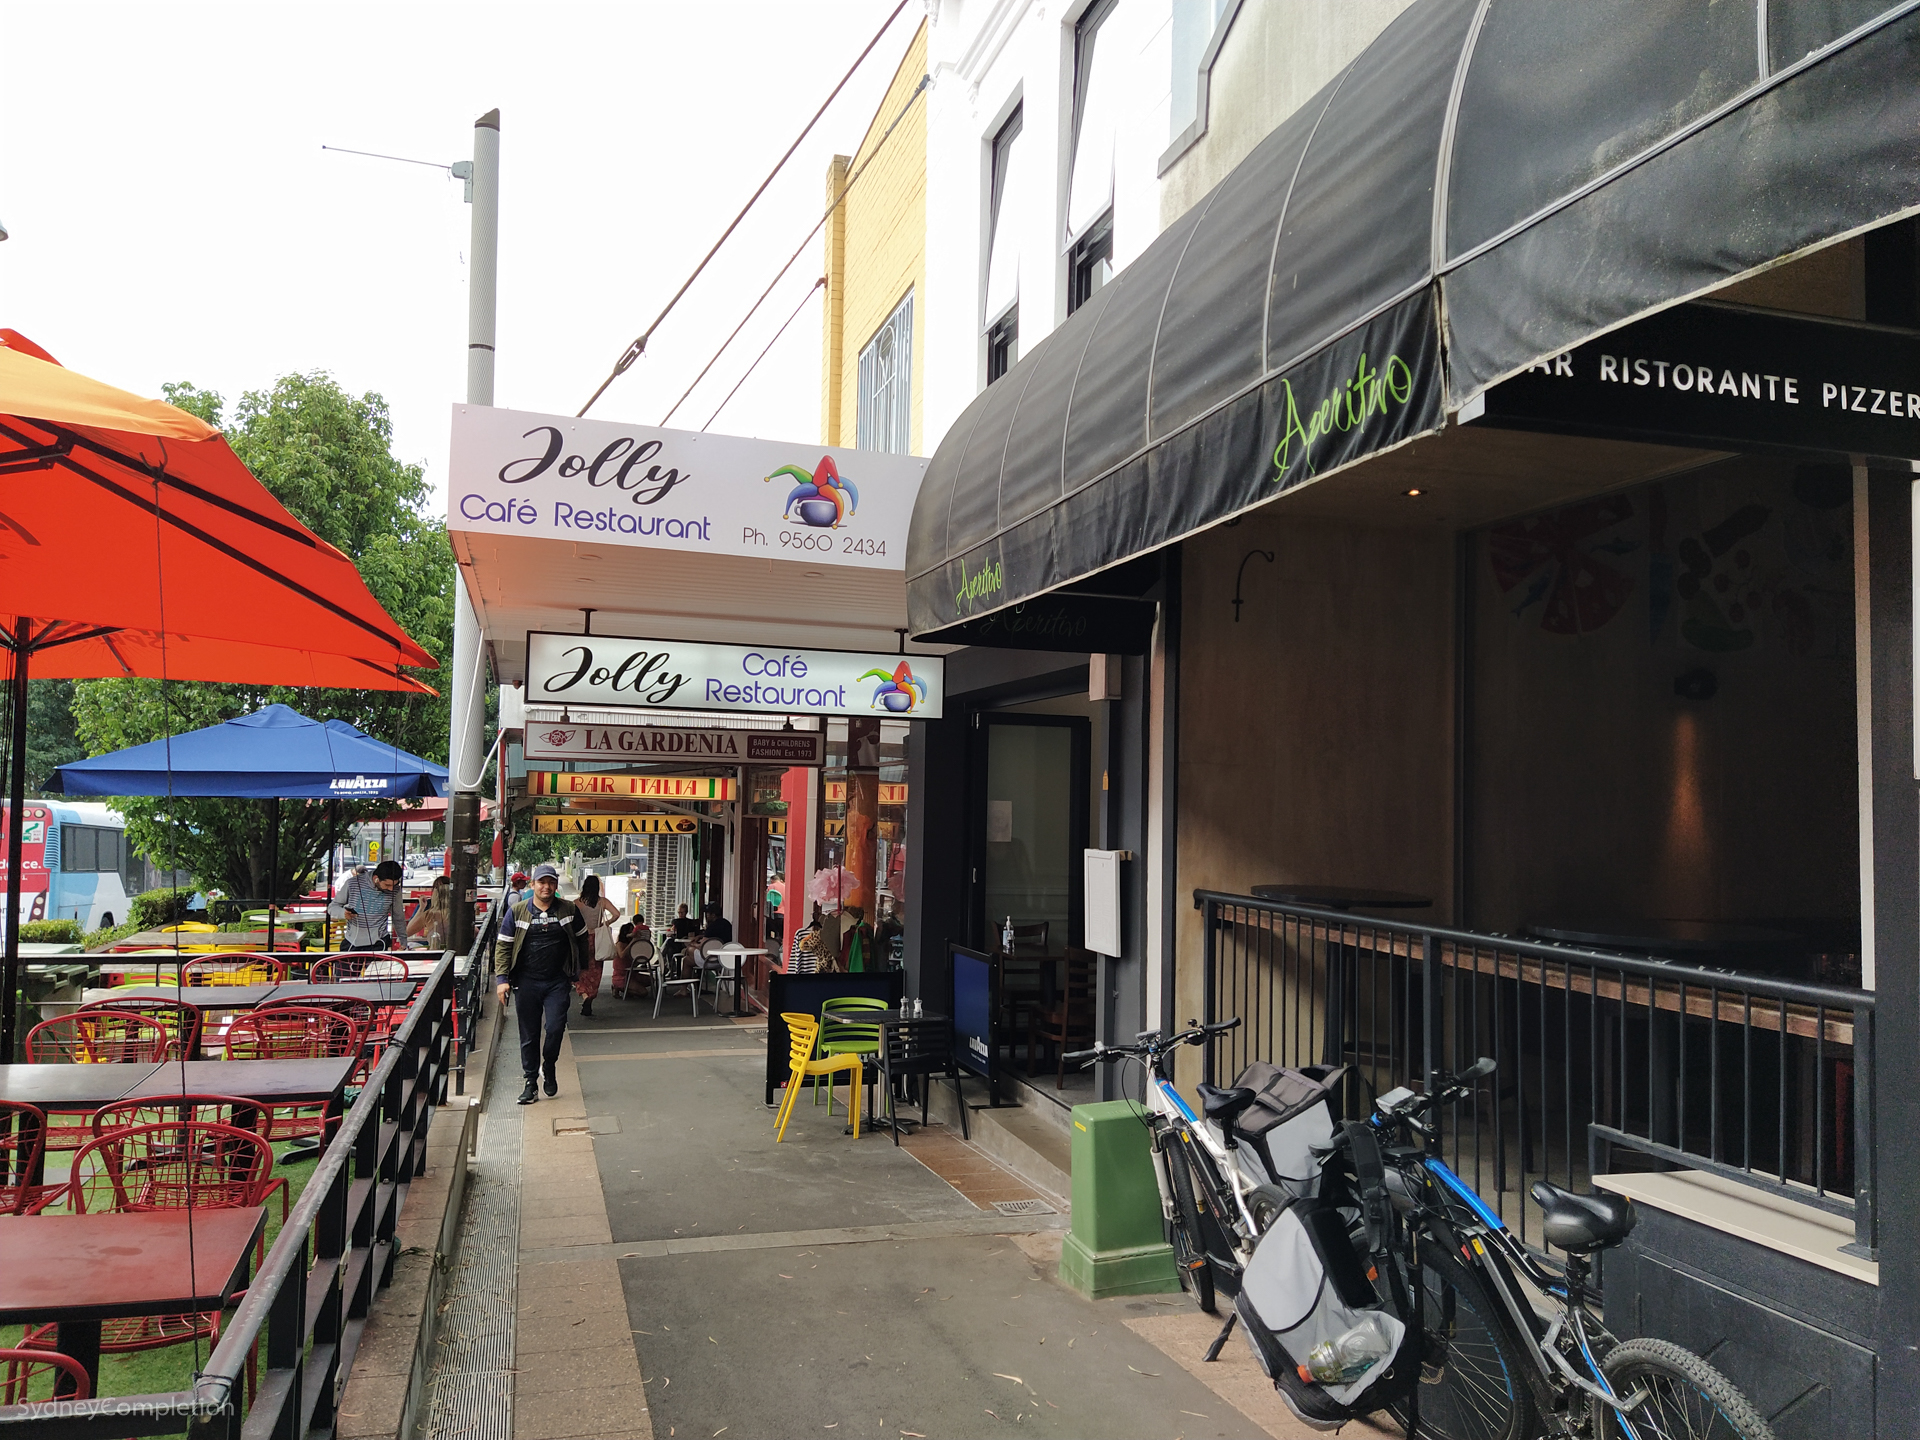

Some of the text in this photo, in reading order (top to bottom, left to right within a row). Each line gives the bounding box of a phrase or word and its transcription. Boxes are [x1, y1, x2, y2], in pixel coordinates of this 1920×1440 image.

[1527, 351, 1574, 377] AR
[1600, 355, 1799, 404] RISTORANTE
[1273, 353, 1412, 482] Aperitivo
[498, 426, 691, 505] Jolly
[459, 493, 711, 541] Café Restaurant
[742, 526, 887, 557] Ph. 9560 2434
[543, 646, 692, 704] Jolly
[742, 652, 808, 678] Café
[705, 678, 846, 708] Restaurant
[584, 730, 738, 755] LA GARDENIA
[751, 748, 781, 756] FASHION
[753, 739, 770, 747] BABY
[777, 740, 811, 748] CHILDRENS
[570, 776, 697, 795] BAR ITALIA
[557, 818, 599, 832] BAR
[606, 818, 674, 832] ITALIA
